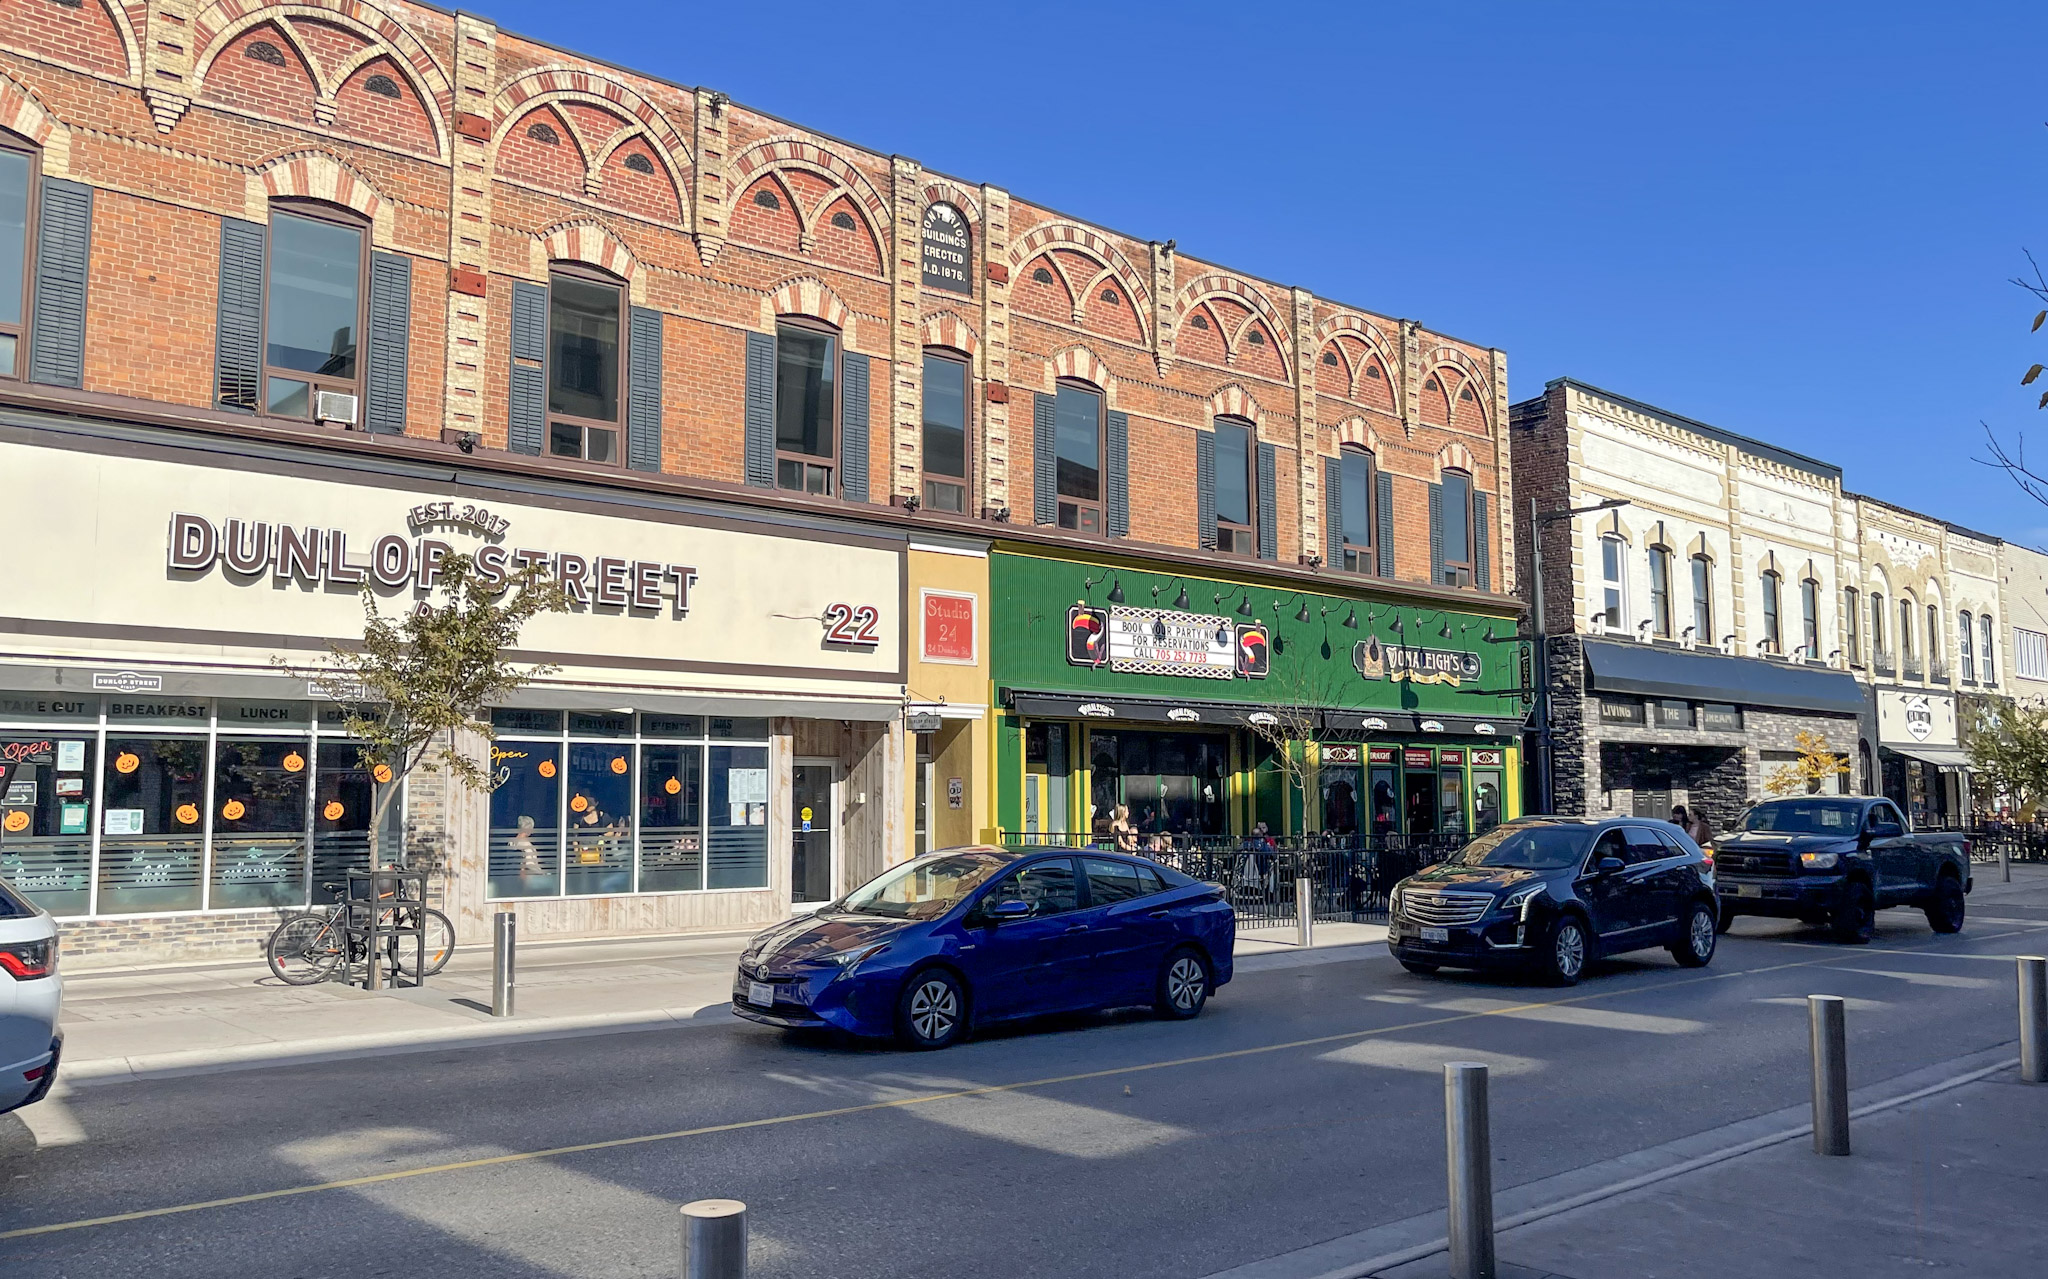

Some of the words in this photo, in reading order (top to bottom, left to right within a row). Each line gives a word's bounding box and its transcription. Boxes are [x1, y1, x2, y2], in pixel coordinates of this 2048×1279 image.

[924, 245, 964, 264] ERECTED
[169, 511, 454, 590] DUNLOP
[474, 543, 699, 612] STREET
[927, 598, 970, 620] Studio
[826, 602, 880, 643] 22
[1122, 622, 1143, 633] BOOK
[1150, 623, 1172, 636] YOUR
[1176, 627, 1202, 639] PARTY
[939, 624, 957, 643] 24
[1132, 635, 1148, 646] FOR
[1152, 637, 1210, 651] RESERVATIONS
[1133, 647, 1154, 658] CALL
[1155, 649, 1171, 661] 705
[1174, 651, 1187, 661] 252
[1189, 652, 1207, 663] 7733
[112, 703, 206, 718] BREAKFAST
[241, 708, 289, 719] LUNCH
[1601, 704, 1632, 718] LIVING
[1662, 708, 1680, 720] THE
[5, 741, 52, 764] Open
[490, 746, 528, 767] Open
